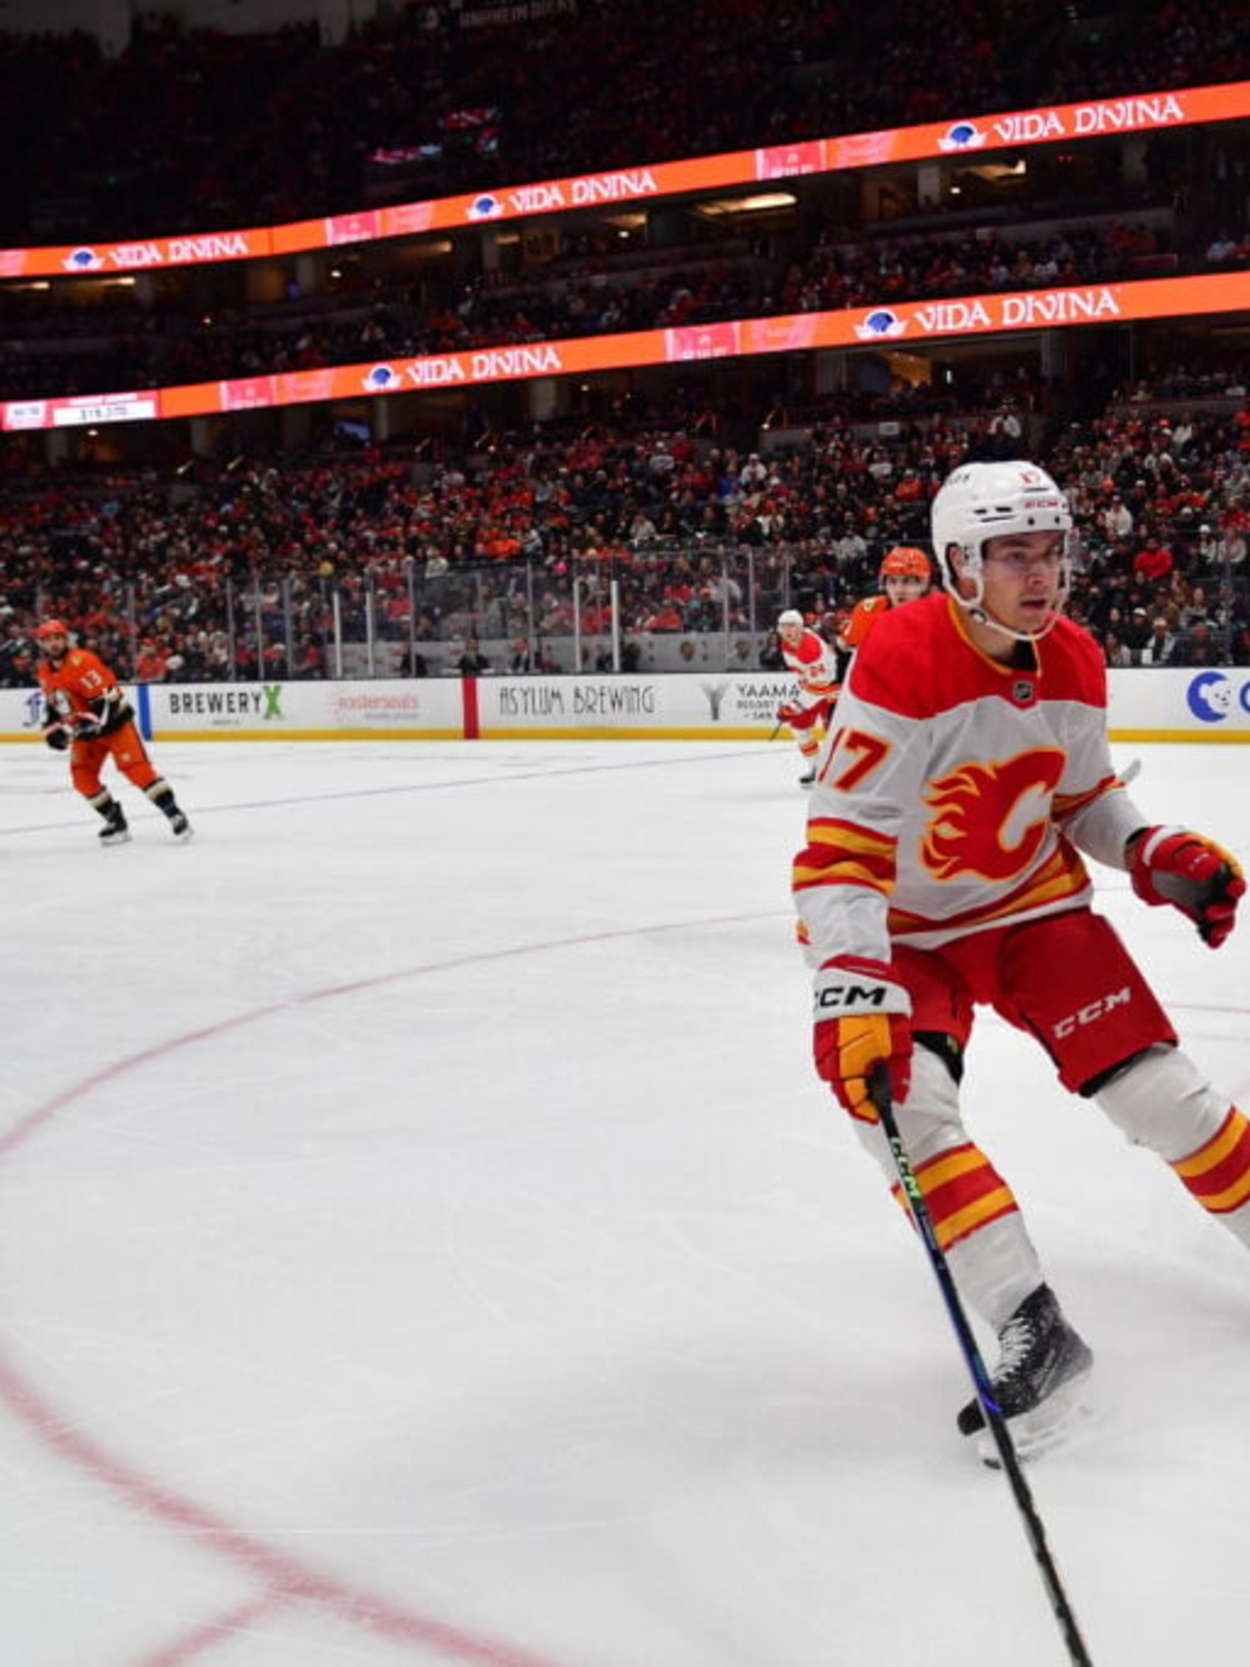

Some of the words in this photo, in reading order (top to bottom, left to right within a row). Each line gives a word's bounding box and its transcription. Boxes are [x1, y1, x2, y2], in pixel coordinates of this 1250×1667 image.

[994, 111, 1065, 142] VIDA
[1074, 96, 1184, 133] DIVINA
[509, 185, 565, 212] VIDA
[571, 170, 657, 204] DIVINA
[109, 242, 163, 267] VIDA
[168, 234, 248, 261] DIVINA
[914, 300, 991, 331] VIDA
[1001, 289, 1120, 325] DIVINA
[406, 357, 465, 384] VIDA
[472, 346, 562, 379] DIVINA
[499, 685, 565, 715] ASYLUM
[573, 685, 655, 714] BREWING
[813, 985, 887, 1008] CM
[1053, 986, 1132, 1039] CCM
